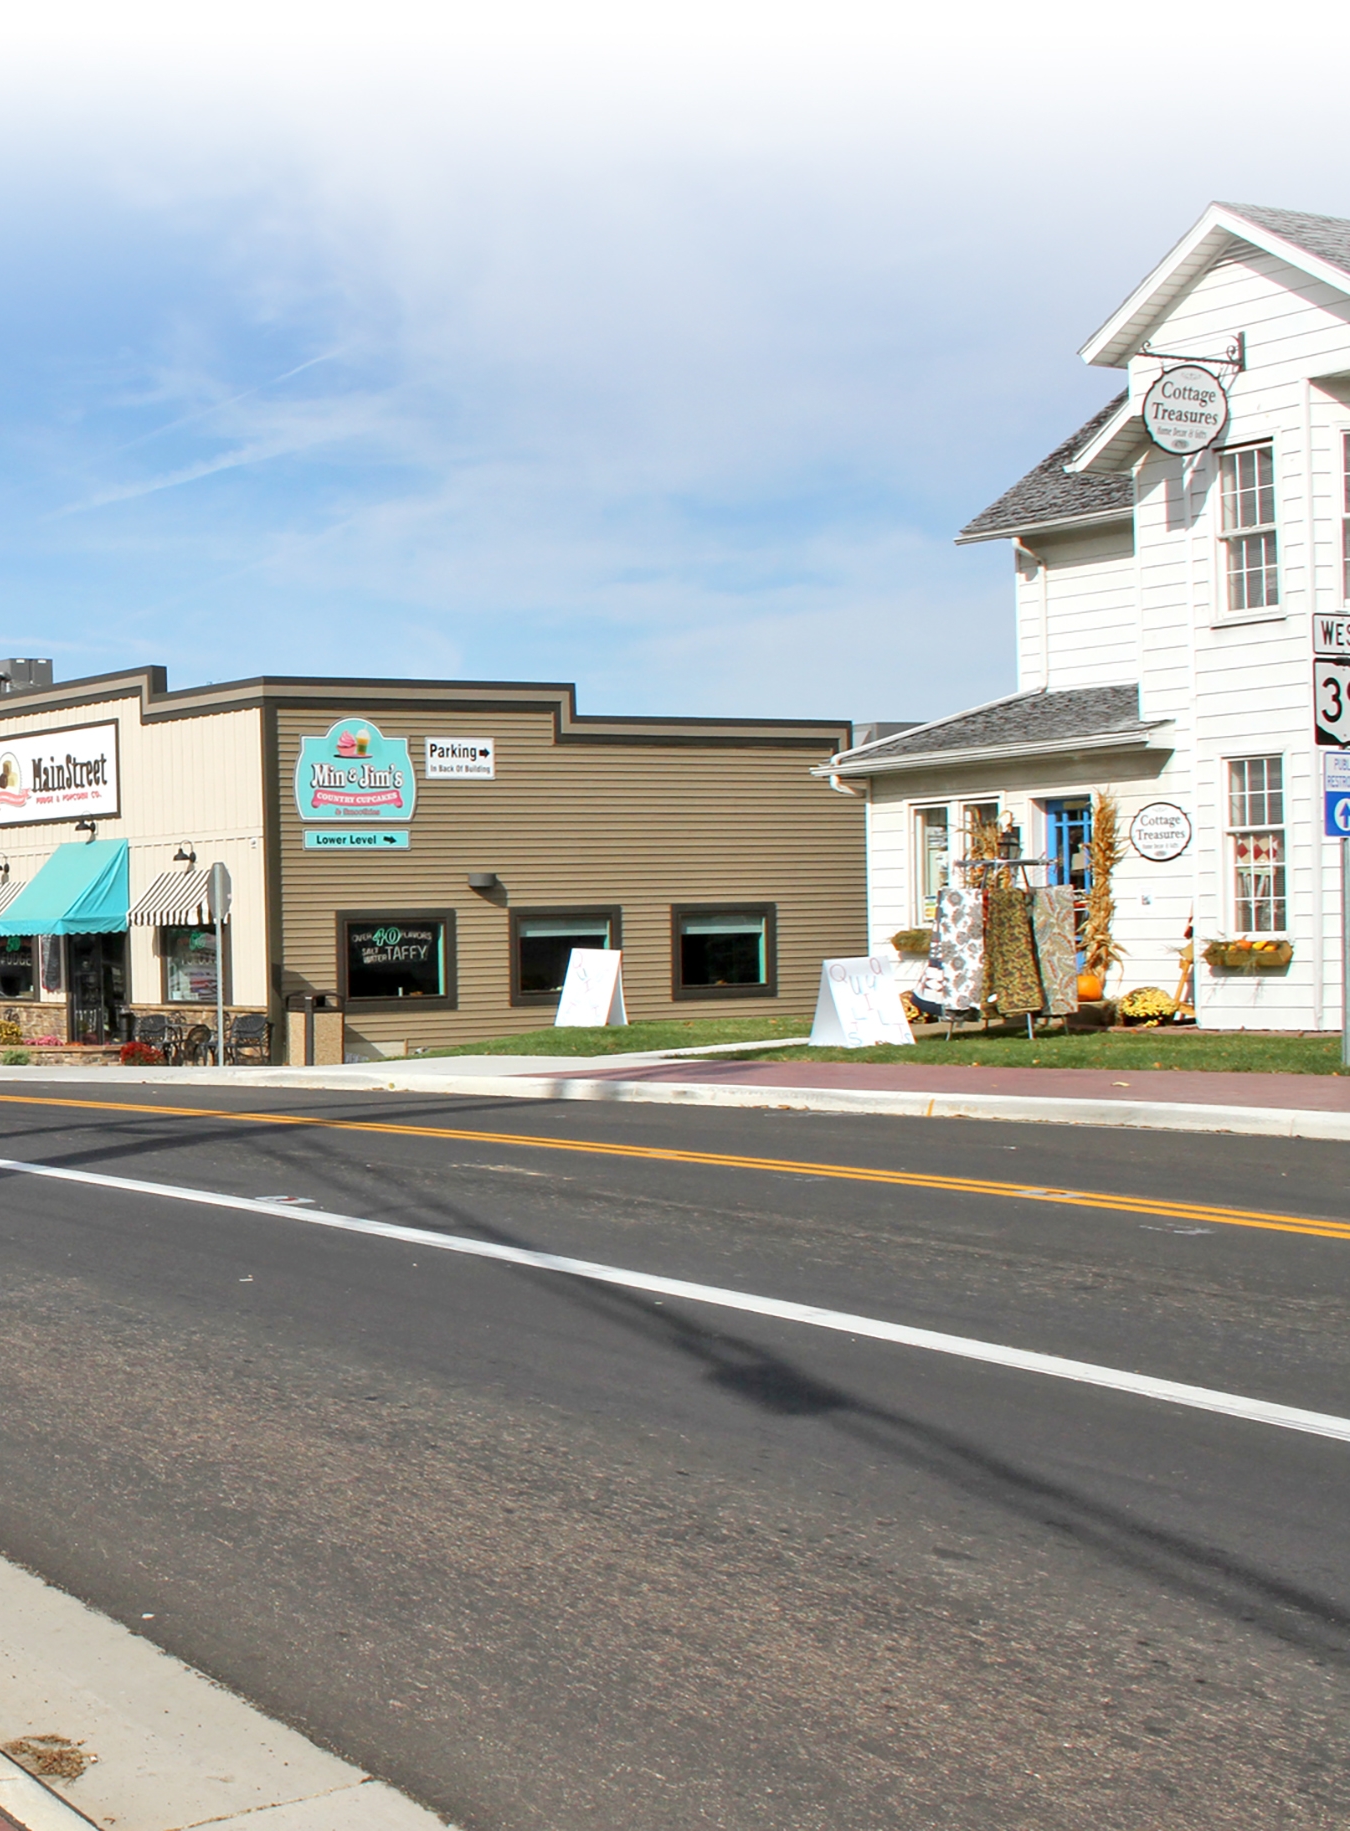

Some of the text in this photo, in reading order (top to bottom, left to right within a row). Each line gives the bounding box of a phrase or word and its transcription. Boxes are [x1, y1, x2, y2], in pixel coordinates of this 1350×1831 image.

[1161, 380, 1217, 408] Cottage
[1152, 402, 1219, 426] Treasures
[1321, 677, 1350, 723] 3
[430, 743, 477, 762] Parking
[310, 763, 404, 789] Min & Jim's
[430, 764, 491, 775] In Back Of Building
[316, 791, 398, 804] COUNTRY CUPCAKES
[1140, 814, 1181, 829] Cottage
[316, 834, 377, 845] Lower Level
[1135, 828, 1186, 841] Treasures
[351, 932, 373, 943] OVER
[372, 926, 401, 947] 40
[0, 951, 32, 967] FUDGE
[362, 947, 379, 956] SALT
[385, 945, 428, 961] TAFFY
